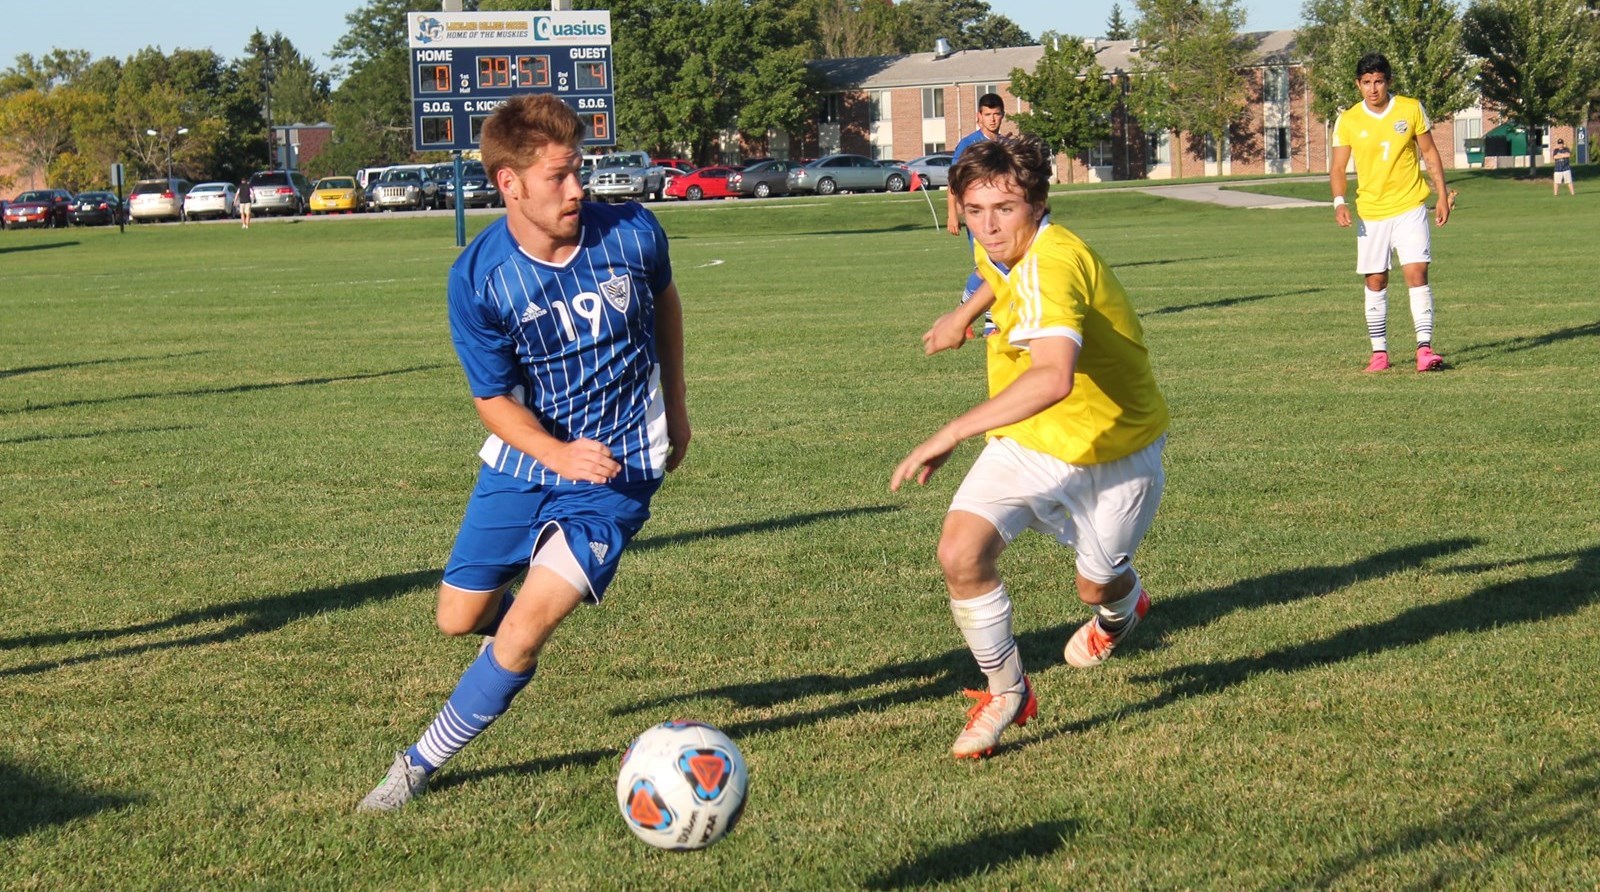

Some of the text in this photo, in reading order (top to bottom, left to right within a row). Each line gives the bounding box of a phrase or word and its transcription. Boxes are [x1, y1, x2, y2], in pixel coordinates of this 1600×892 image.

[534, 16, 607, 40] Quasius
[446, 31, 468, 39] HOME
[496, 30, 529, 38] MUSKIES
[416, 49, 453, 62] HOME
[569, 47, 607, 59] GUEST
[591, 64, 605, 87] 4
[422, 101, 453, 113] S.O.G.
[463, 101, 475, 112] C.
[578, 98, 608, 109] S.O.G.
[593, 114, 606, 137] 8
[551, 291, 602, 342] 19
